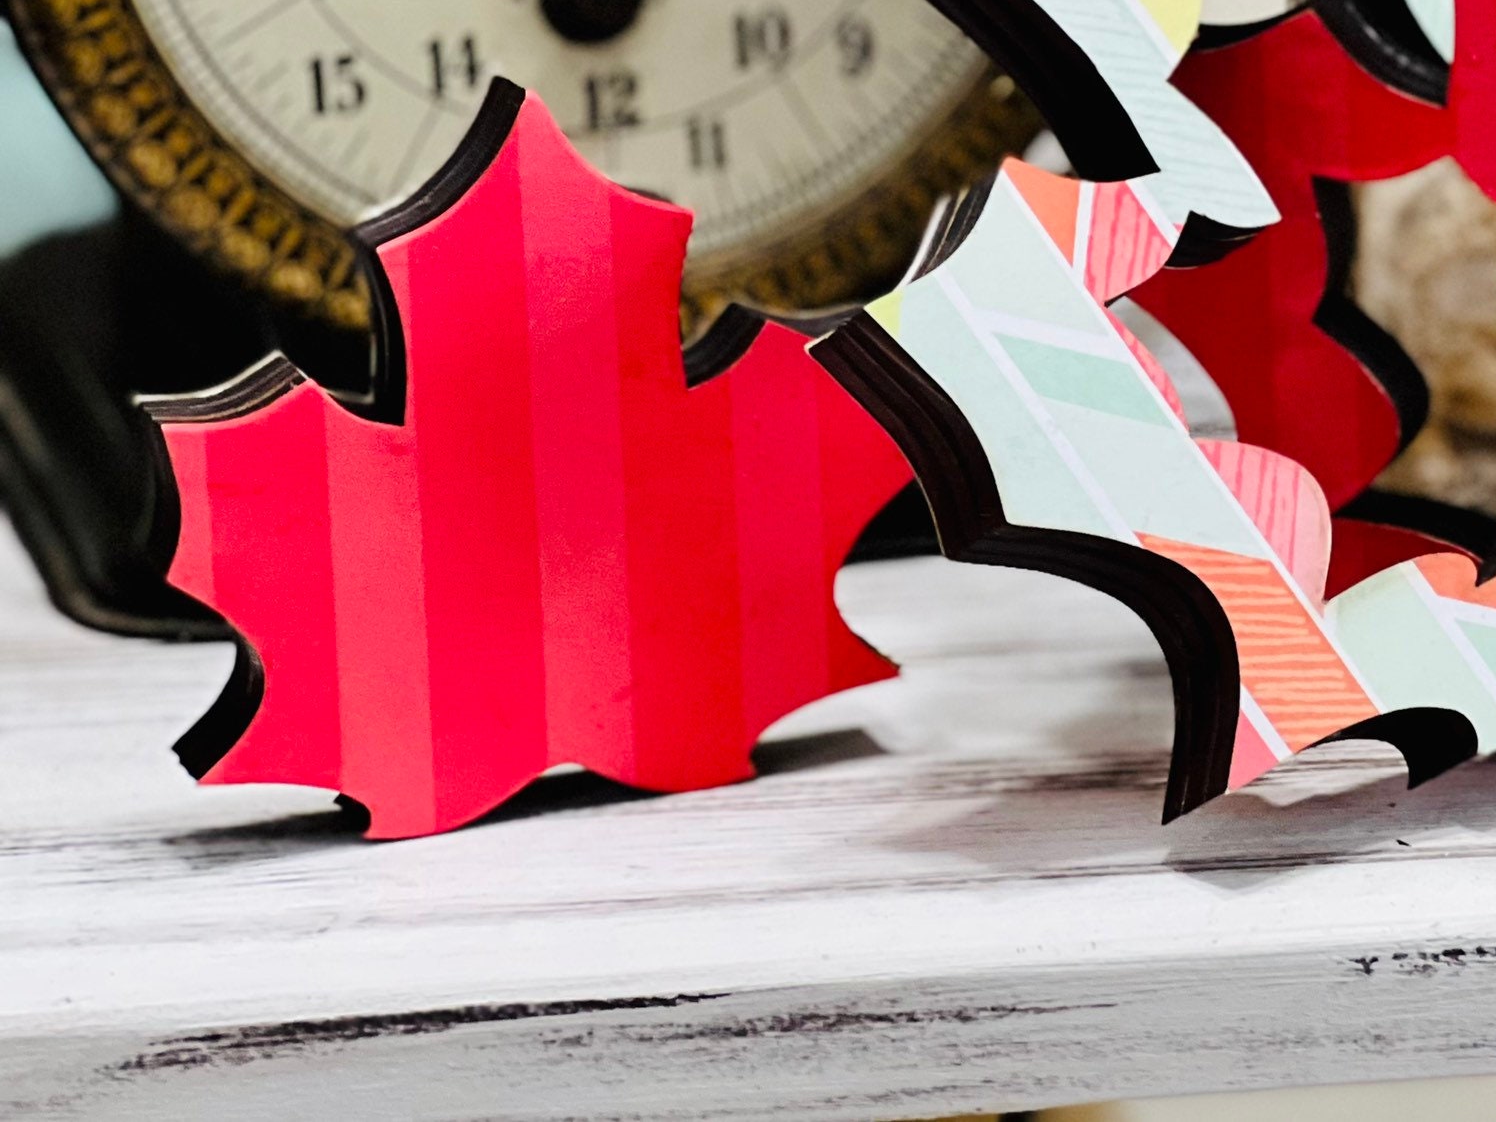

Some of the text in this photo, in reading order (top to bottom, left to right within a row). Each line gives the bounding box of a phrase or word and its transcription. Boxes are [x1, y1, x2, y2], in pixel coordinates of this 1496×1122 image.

[427, 32, 482, 101] 14
[731, 3, 793, 76] 10
[834, 10, 876, 78] 9
[309, 52, 368, 116] 15
[582, 70, 641, 134] 12
[685, 113, 728, 171] 11
